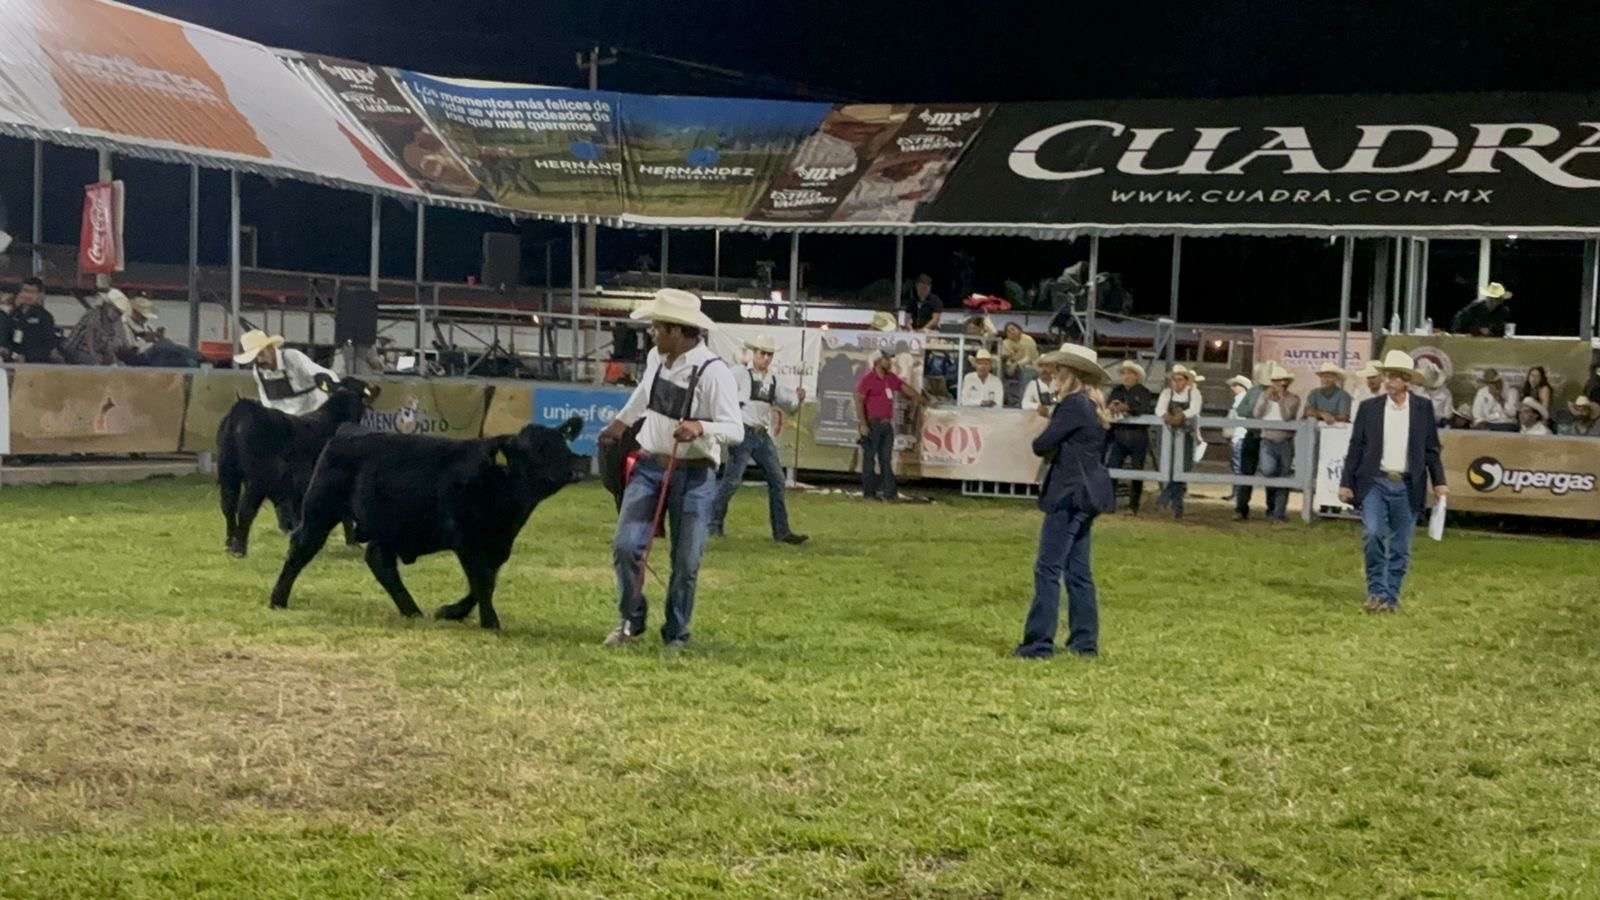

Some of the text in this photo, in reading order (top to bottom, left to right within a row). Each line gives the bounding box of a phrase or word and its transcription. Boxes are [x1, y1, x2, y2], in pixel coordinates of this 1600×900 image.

[440, 91, 514, 110] momentos
[515, 98, 545, 111] más
[546, 98, 592, 112] felices
[593, 100, 611, 112] de
[484, 107, 523, 120] viven
[526, 109, 591, 122] rodeados
[592, 111, 611, 123] de
[467, 116, 493, 129] que
[495, 117, 526, 130] más
[527, 120, 597, 134] queremos
[1111, 188, 1494, 204] WWW.CUADRA.COM.MX
[1284, 349, 1361, 360] AUTENTCA
[543, 403, 597, 422] unicef
[1466, 456, 1597, 496] Supergas
